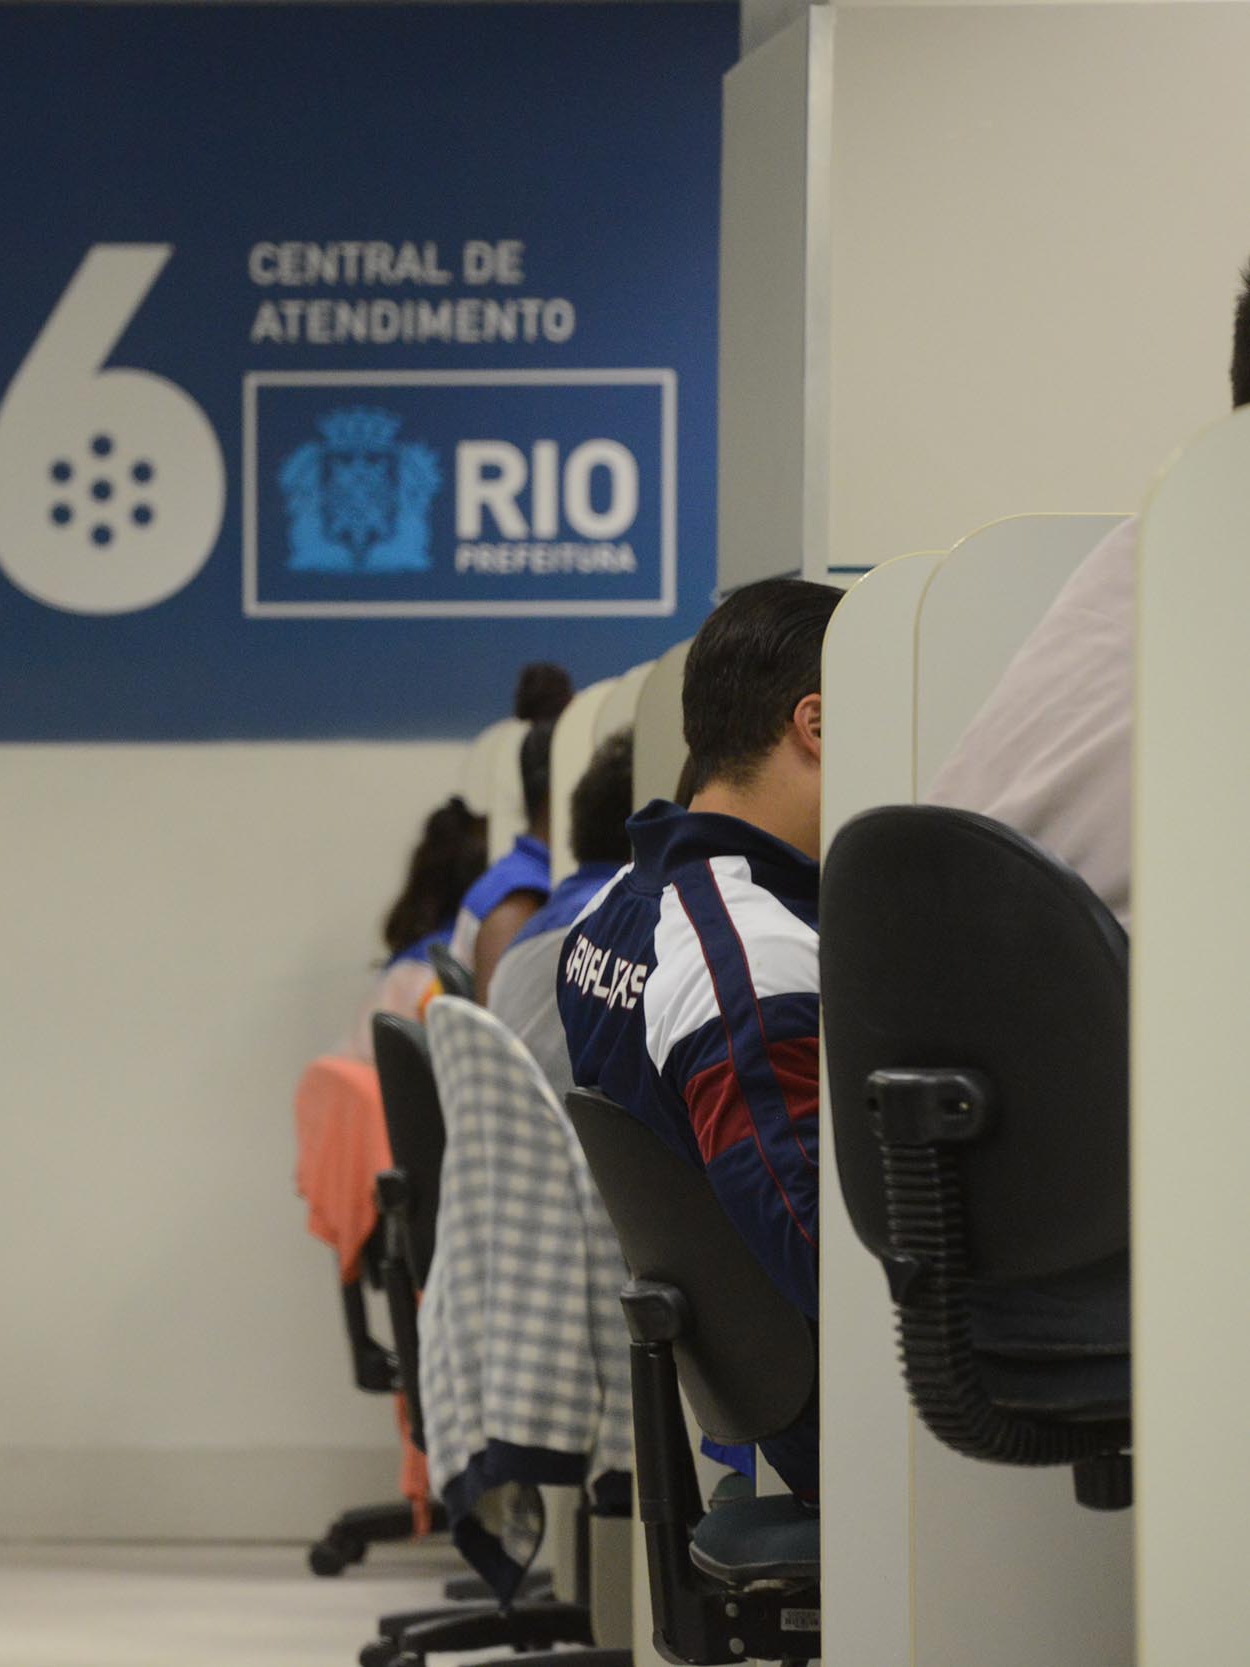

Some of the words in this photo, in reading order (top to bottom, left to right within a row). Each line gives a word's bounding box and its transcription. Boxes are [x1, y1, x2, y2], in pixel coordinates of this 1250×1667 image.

[249, 242, 450, 285] CENTRAL
[463, 241, 525, 284] DE
[251, 298, 576, 344] ATENDIMENTO
[454, 438, 640, 541] RIO
[454, 542, 638, 575] PREFEITURA
